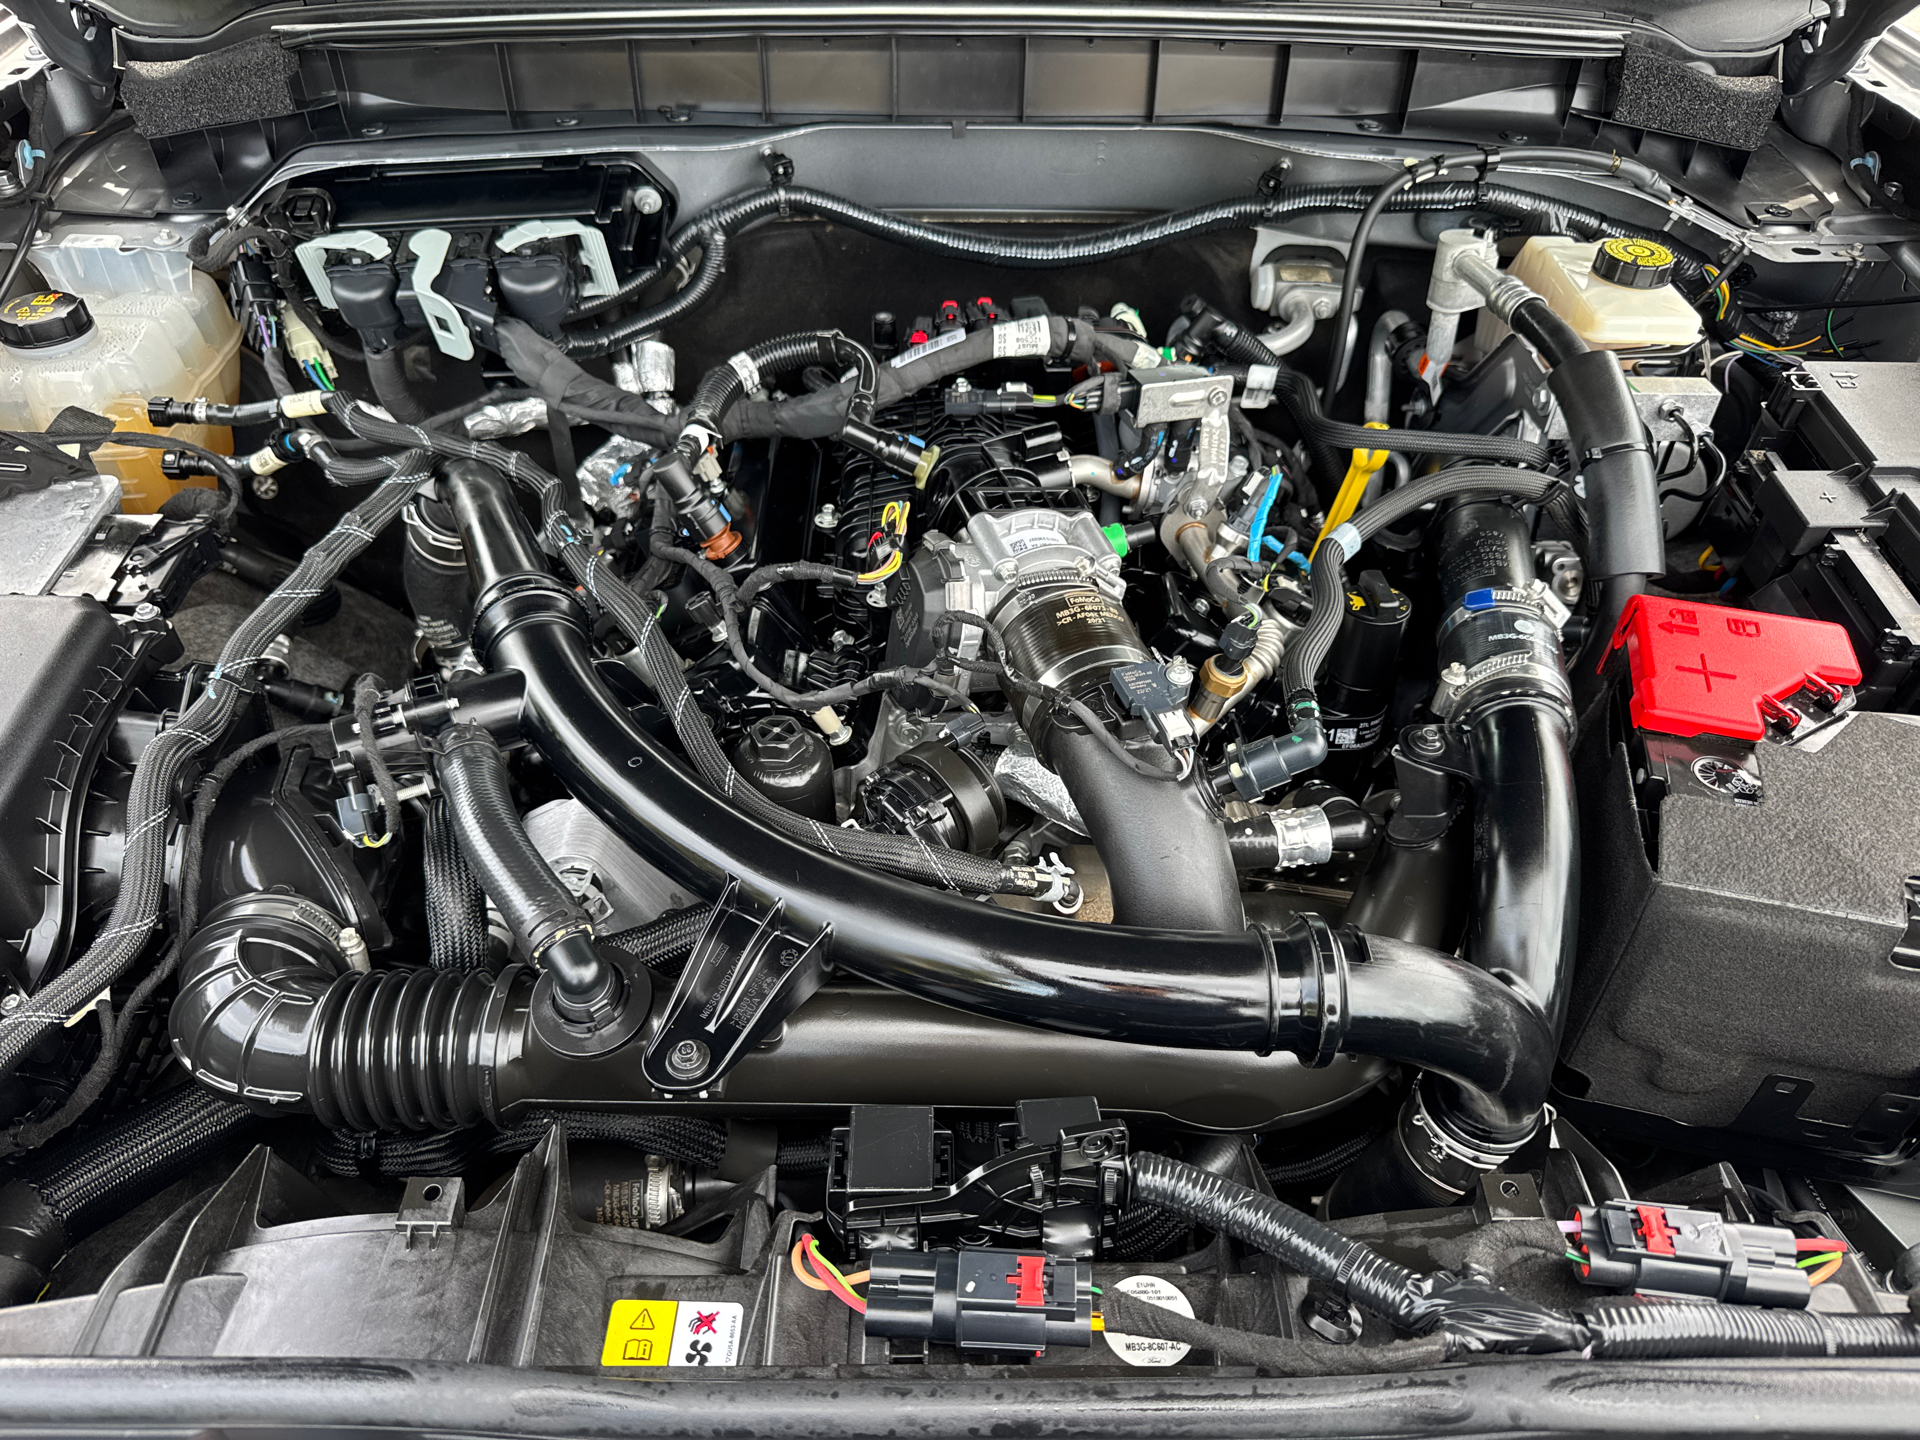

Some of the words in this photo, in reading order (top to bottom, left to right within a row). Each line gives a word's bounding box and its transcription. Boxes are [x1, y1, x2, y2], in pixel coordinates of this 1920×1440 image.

[1069, 596, 1101, 605] FoMoCo
[632, 1182, 640, 1216] FoMoCo
[1125, 1342, 1182, 1351] MB3G-8C607-AC
